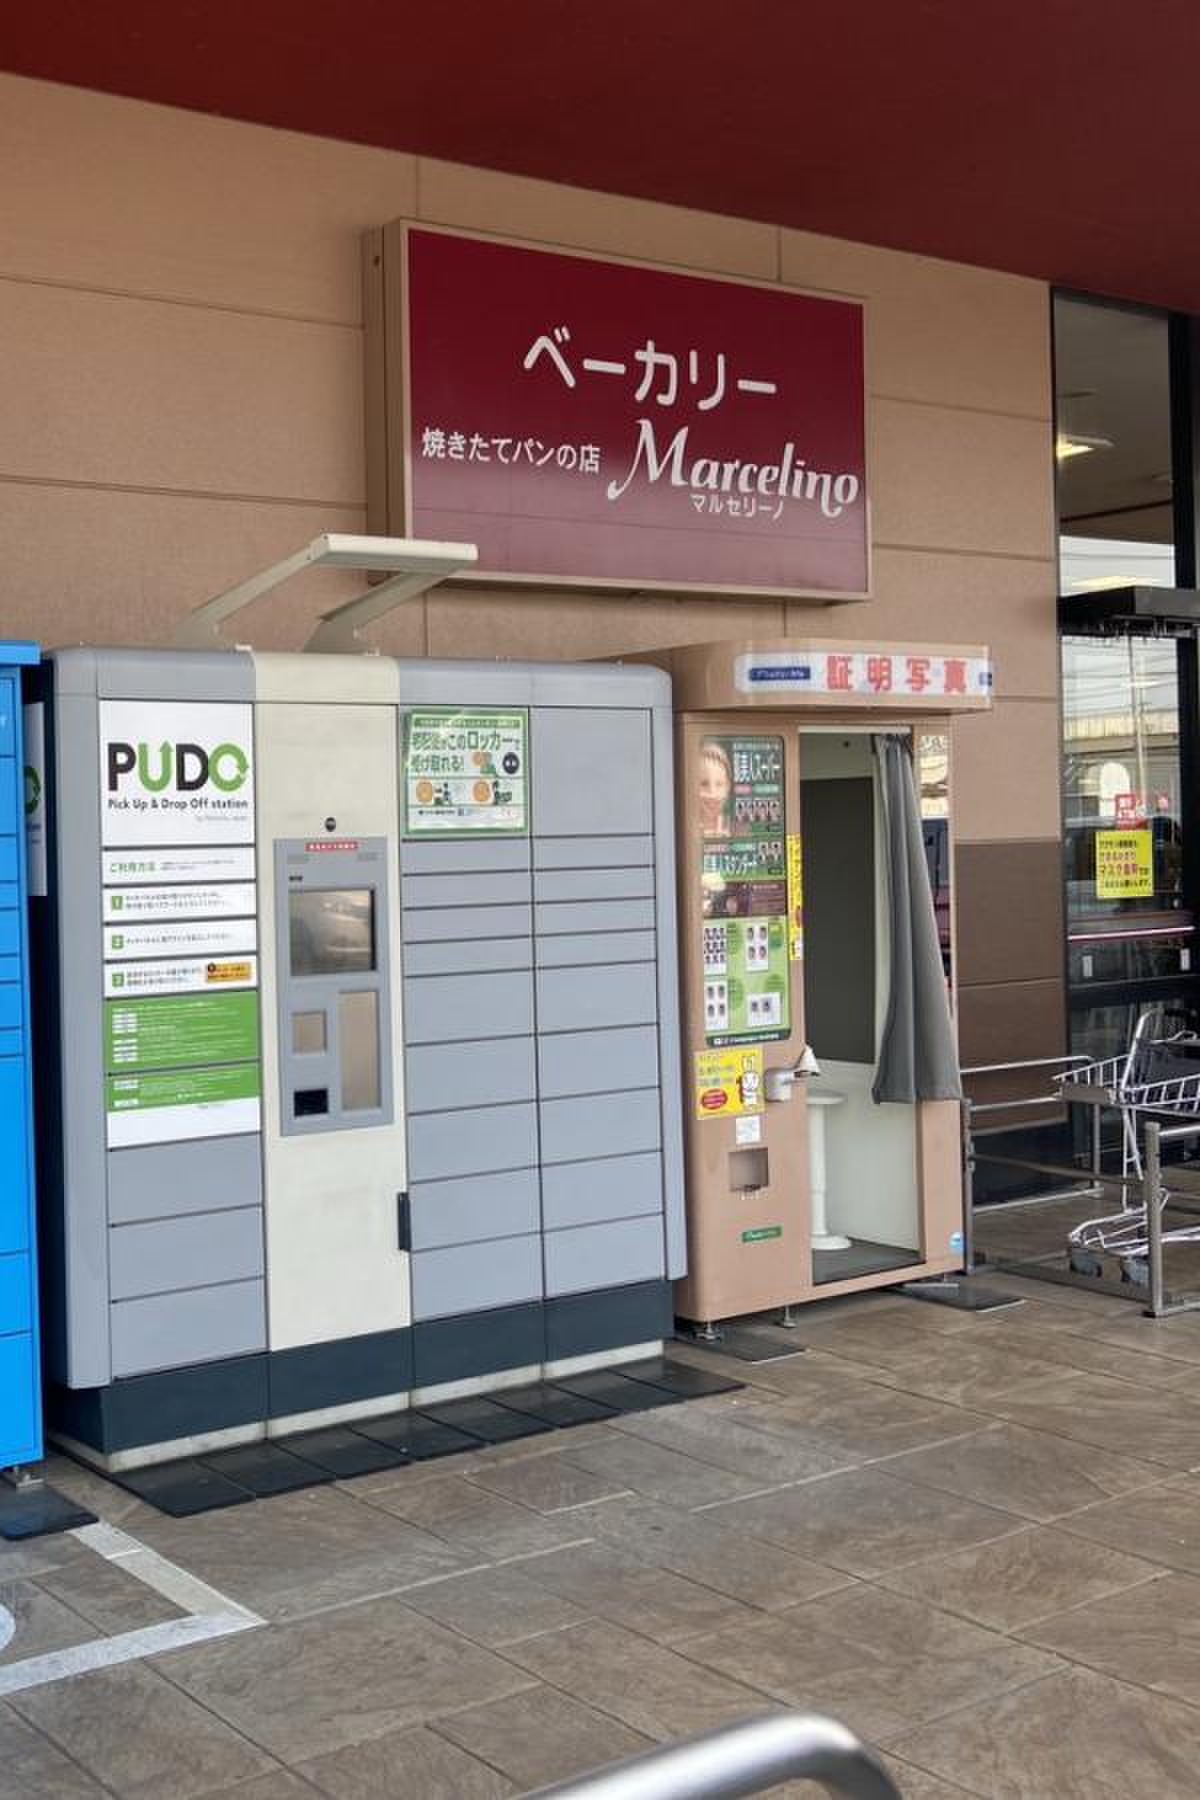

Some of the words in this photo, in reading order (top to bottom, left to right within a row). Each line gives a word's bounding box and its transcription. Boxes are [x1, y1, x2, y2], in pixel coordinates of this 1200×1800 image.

[523, 326, 776, 410] ベーカリー
[421, 426, 600, 474] 焼きたてパンの店
[607, 418, 859, 518] Marcelino
[690, 494, 785, 520] マルセリーノ
[827, 655, 967, 693] 証明写真
[108, 741, 250, 792] PUDO
[107, 798, 130, 810] Pick
[133, 798, 149, 811] Up
[161, 798, 188, 811] Drop
[190, 798, 209, 809] Off
[211, 799, 249, 810] station
